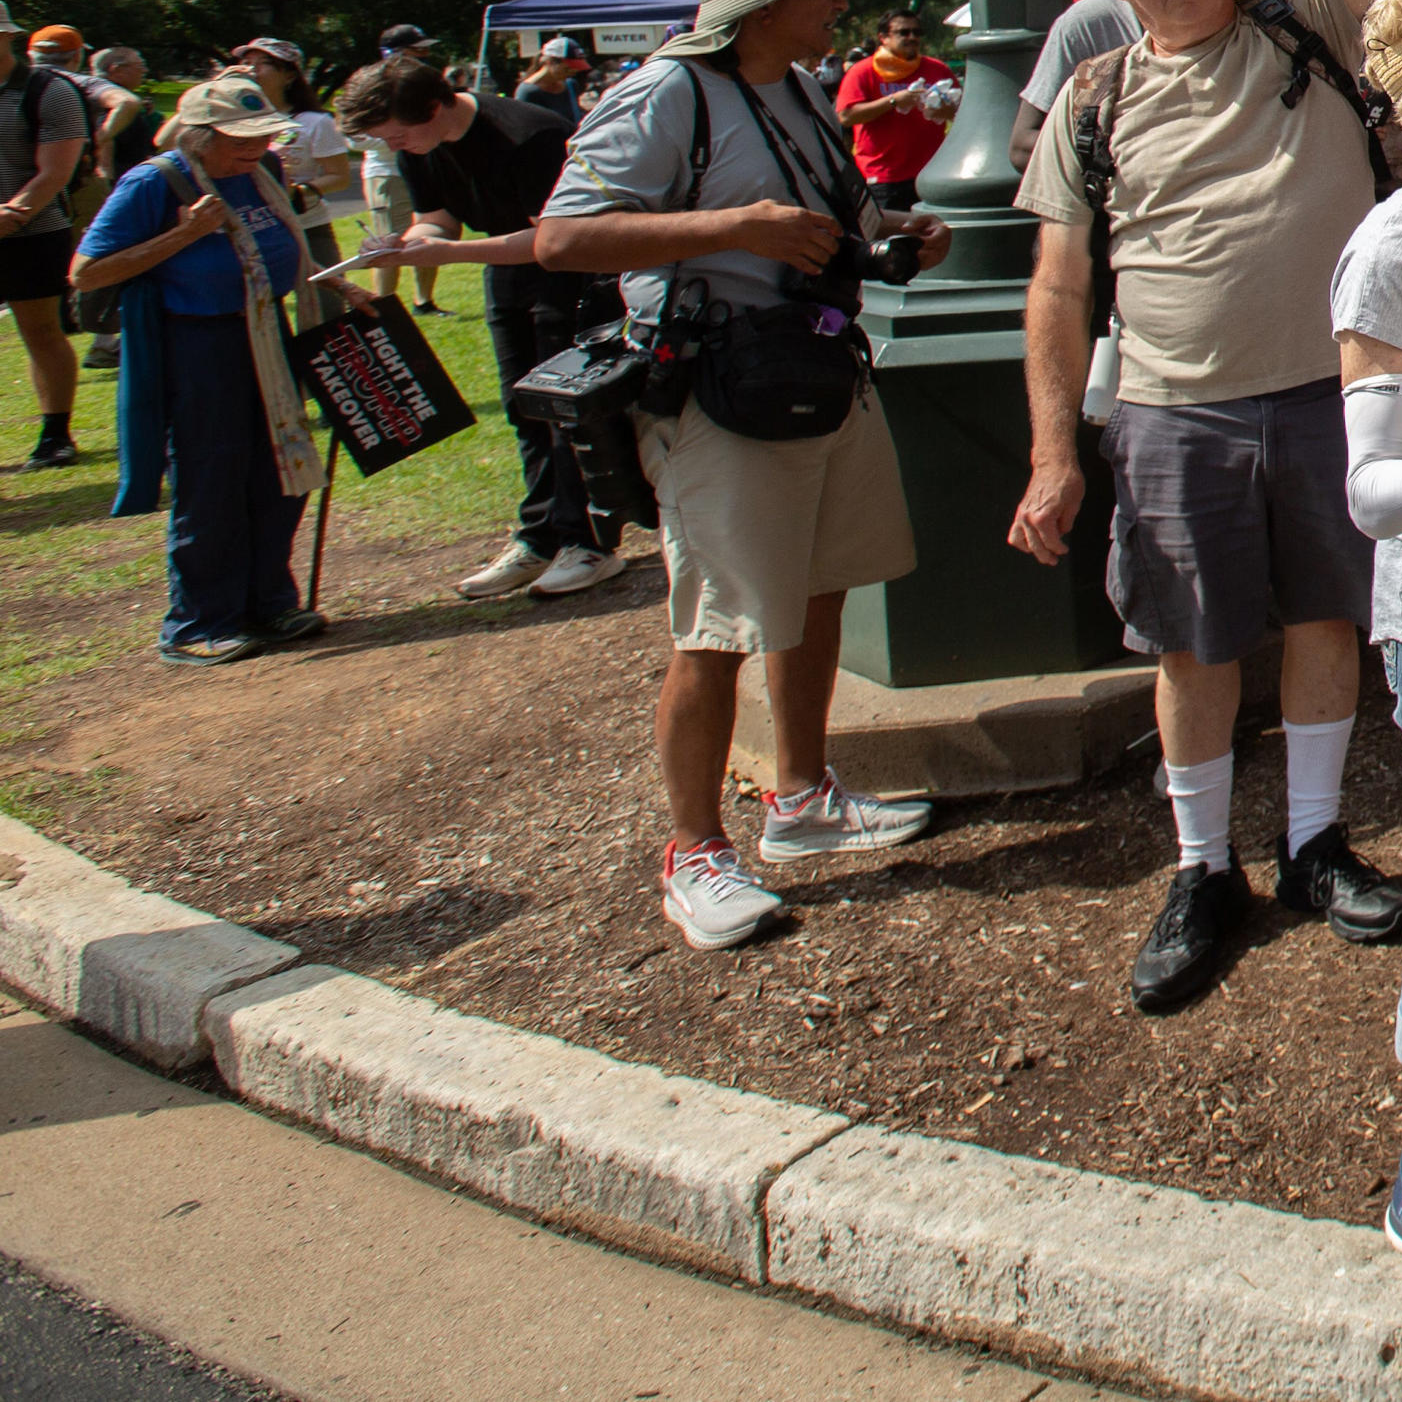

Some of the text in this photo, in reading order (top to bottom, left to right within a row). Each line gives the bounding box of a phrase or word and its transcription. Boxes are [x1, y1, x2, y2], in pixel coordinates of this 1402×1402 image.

[601, 33, 648, 43] WATER
[309, 350, 381, 451] TAKEOVER
[364, 326, 438, 422] FIGHT THE
